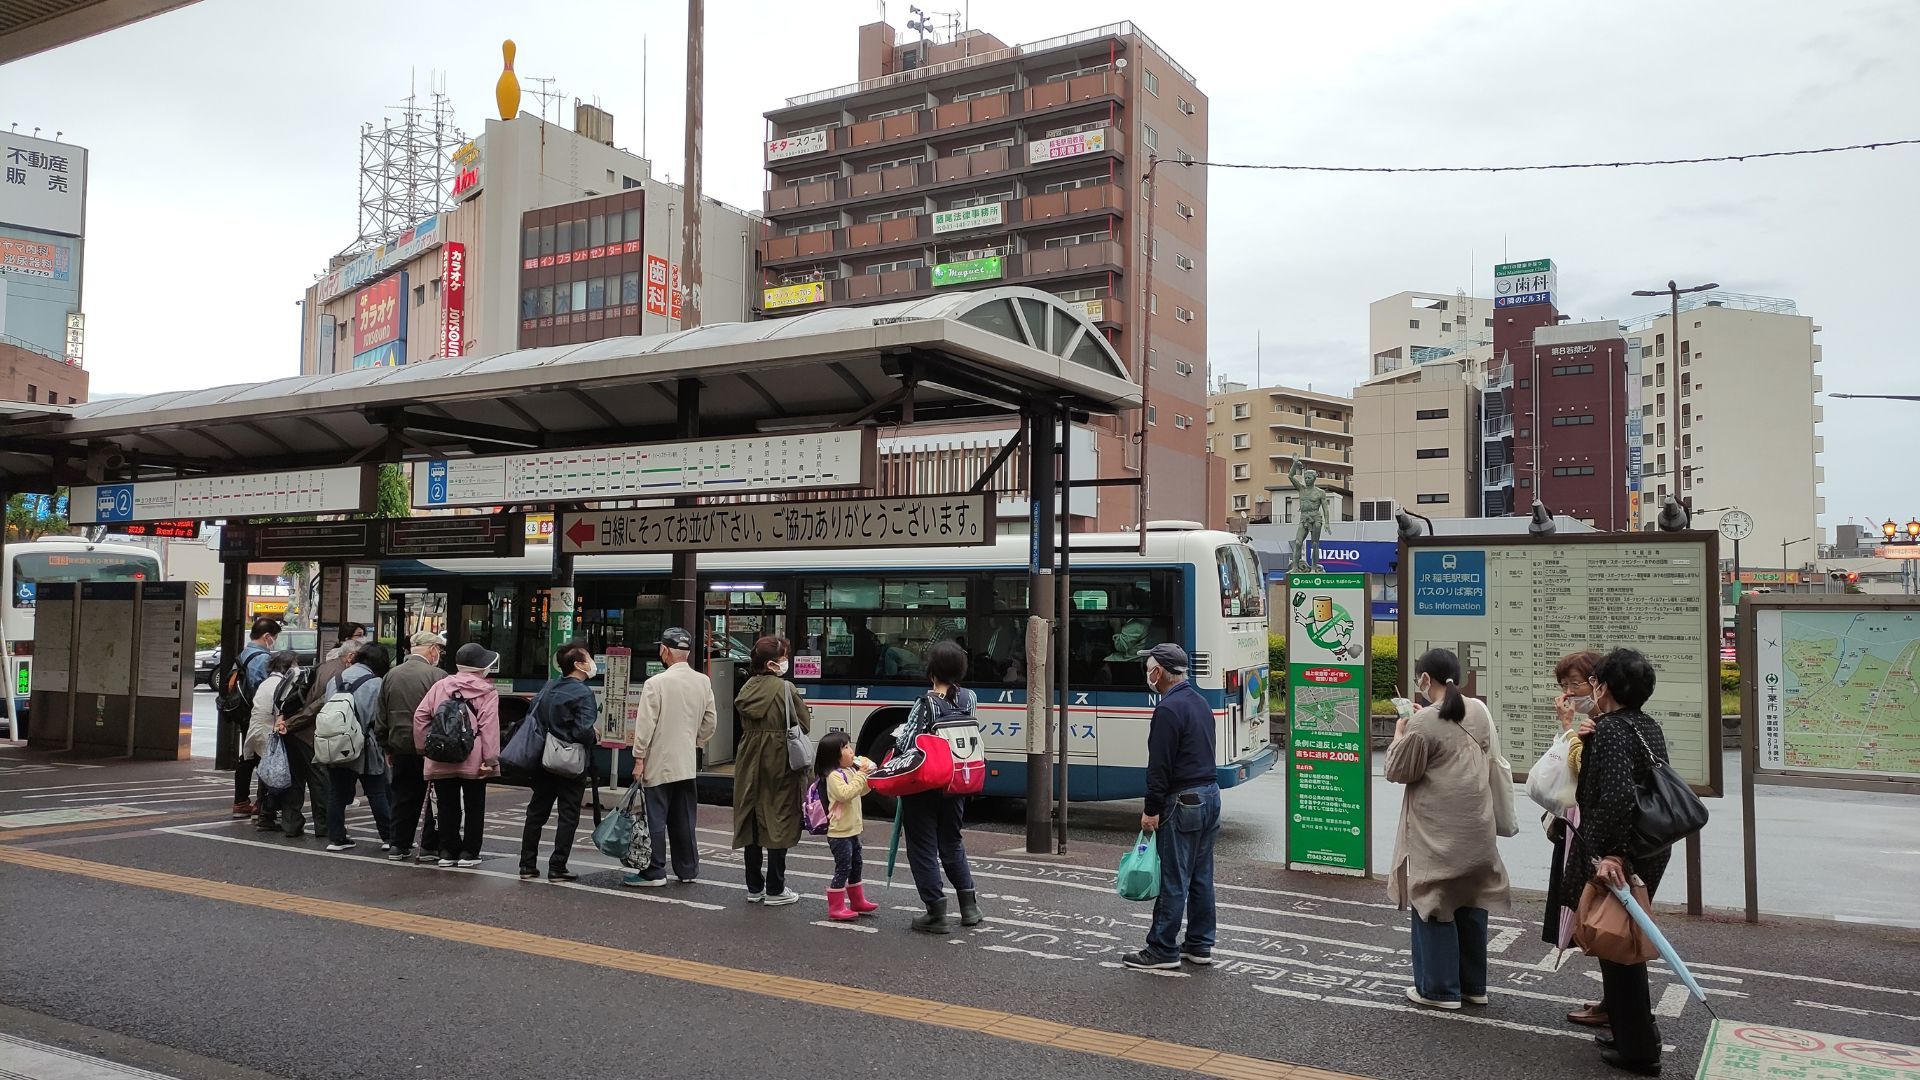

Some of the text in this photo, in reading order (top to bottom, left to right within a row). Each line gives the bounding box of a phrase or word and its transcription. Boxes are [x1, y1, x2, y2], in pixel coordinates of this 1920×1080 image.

[769, 133, 825, 153] ギタースクール
[7, 146, 69, 174] 不動産
[627, 242, 638, 253] 7F
[450, 251, 461, 291] カラオケ
[649, 259, 667, 313] 歯科
[1516, 274, 1549, 293] 歯科
[1536, 293, 1546, 302] 3F
[360, 295, 396, 332] カラオケ
[448, 308, 460, 357] JOYSOUN
[434, 486, 440, 498] 2
[119, 494, 127, 511] 2
[601, 500, 977, 546] 白線にそってお並び下さい。 ご協力ありがとうございます。
[1420, 573, 1480, 583] JR 稲毛駅東口
[1417, 587, 1483, 597] バスのりば案内
[1419, 602, 1481, 610] Bus Information
[1767, 686, 1778, 711] 千葉市
[1294, 739, 1360, 751] 条例に違反した場合
[1295, 750, 1359, 762] 直ちに過料 2,000円
